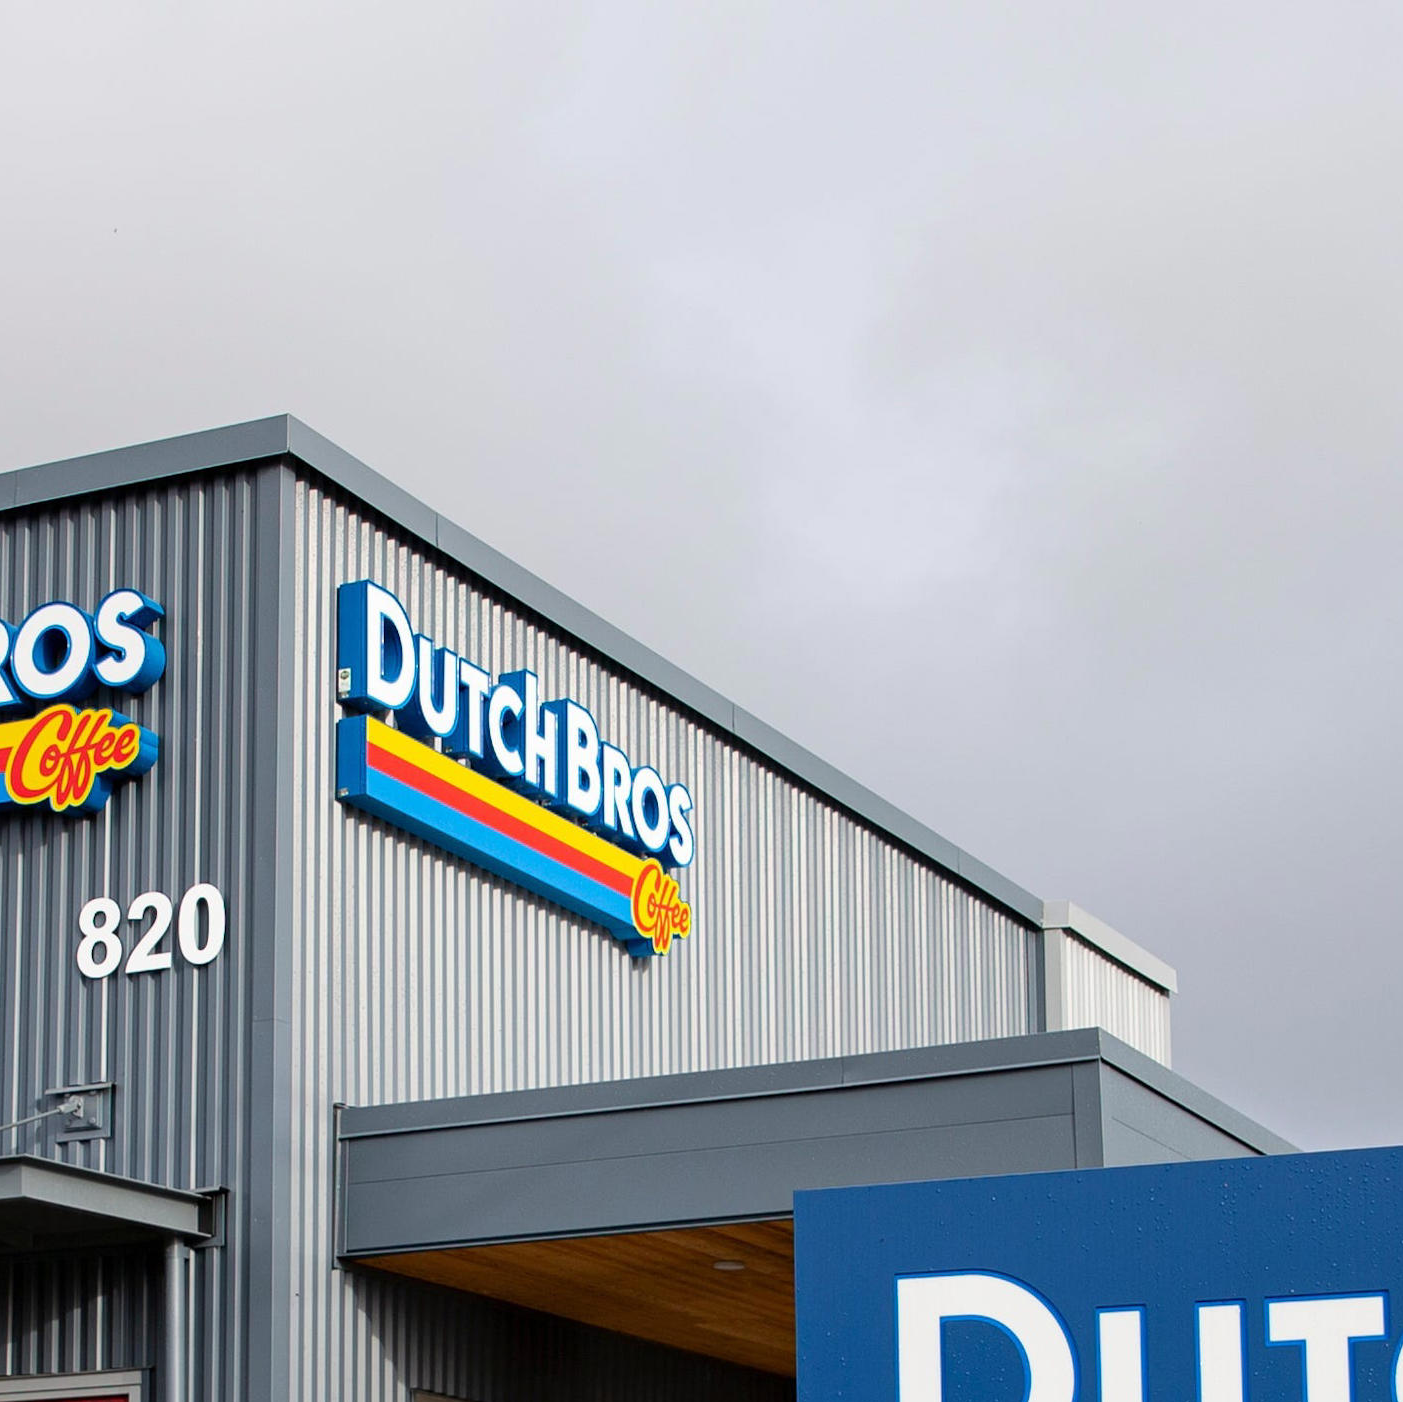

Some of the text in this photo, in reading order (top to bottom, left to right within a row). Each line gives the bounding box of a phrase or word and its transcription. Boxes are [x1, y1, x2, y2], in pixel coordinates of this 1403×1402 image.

[10, 706, 139, 806] Coffee
[366, 581, 694, 866] DUTCH BROS
[75, 882, 227, 979] 820
[634, 864, 691, 950] Coffee
